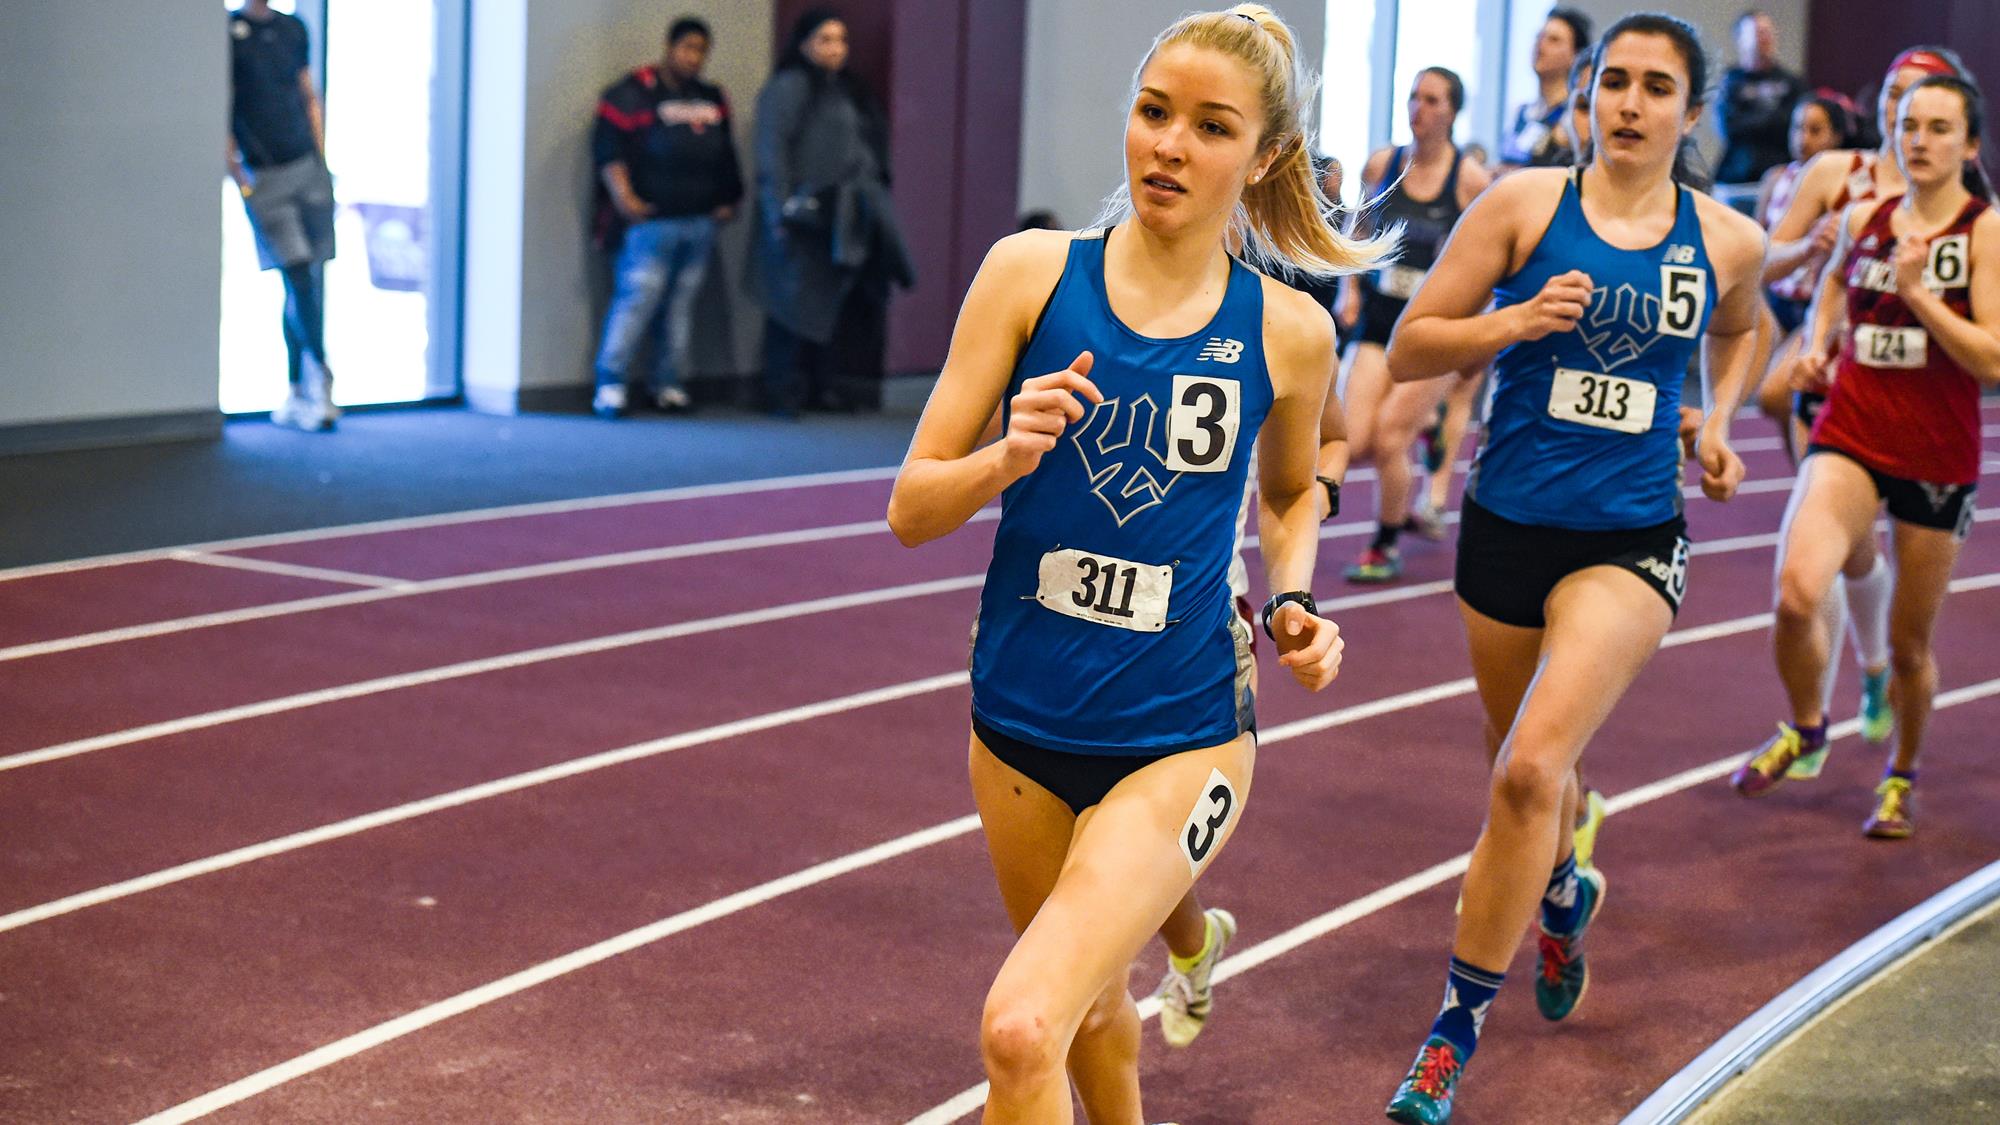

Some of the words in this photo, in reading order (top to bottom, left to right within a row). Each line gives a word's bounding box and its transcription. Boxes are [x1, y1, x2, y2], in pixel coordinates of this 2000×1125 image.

[1934, 241, 1961, 282] 6
[1666, 271, 1698, 331] 5
[1196, 337, 1244, 363] NB
[1870, 332, 1906, 361] 124
[1177, 382, 1228, 466] 3
[1575, 376, 1631, 421] 313
[1071, 557, 1138, 618] 311
[1187, 784, 1232, 862] 3
